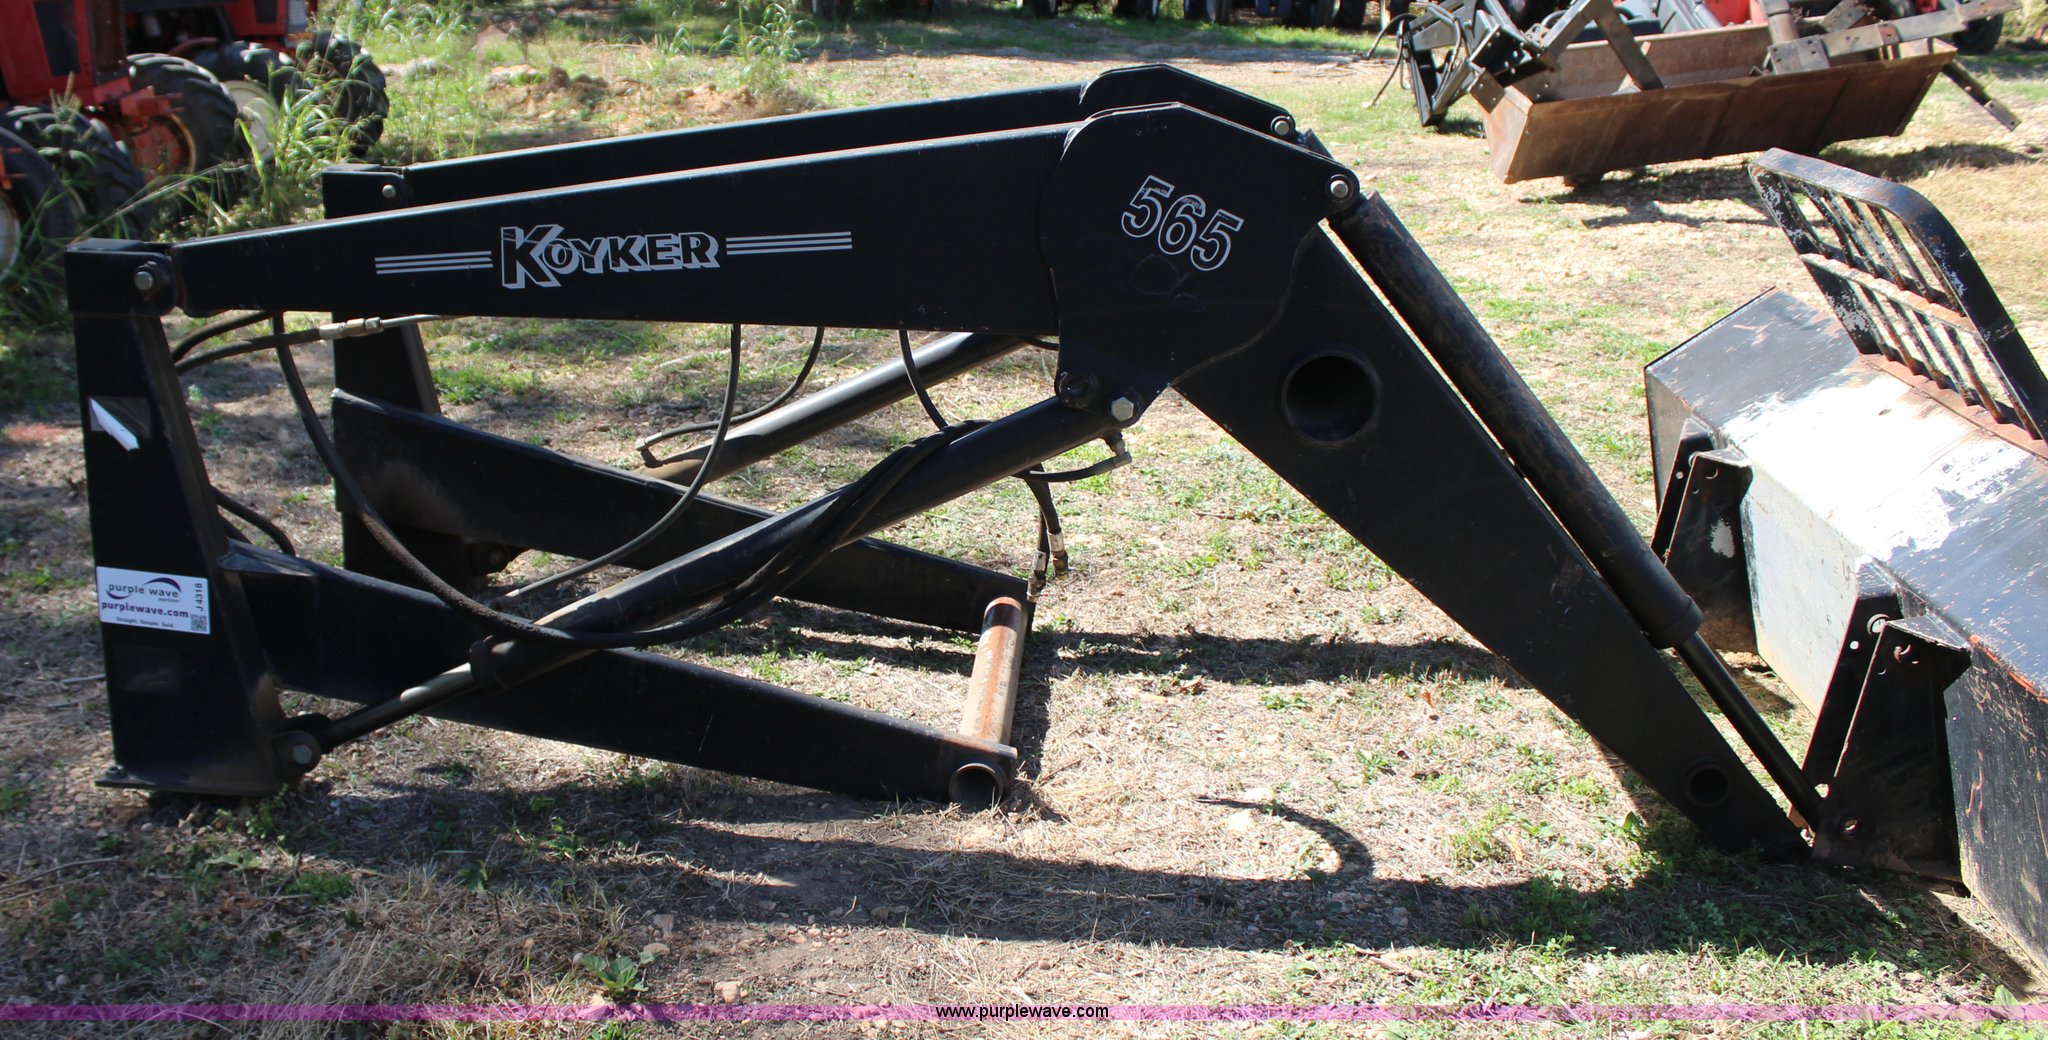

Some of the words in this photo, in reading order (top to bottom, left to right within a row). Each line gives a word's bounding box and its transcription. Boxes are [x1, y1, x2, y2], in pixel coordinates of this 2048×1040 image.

[1121, 174, 1245, 272] 565
[501, 224, 721, 289] KOYKER
[101, 602, 189, 618] purplewave.com
[108, 584, 145, 595] purple
[149, 588, 179, 597] wave
